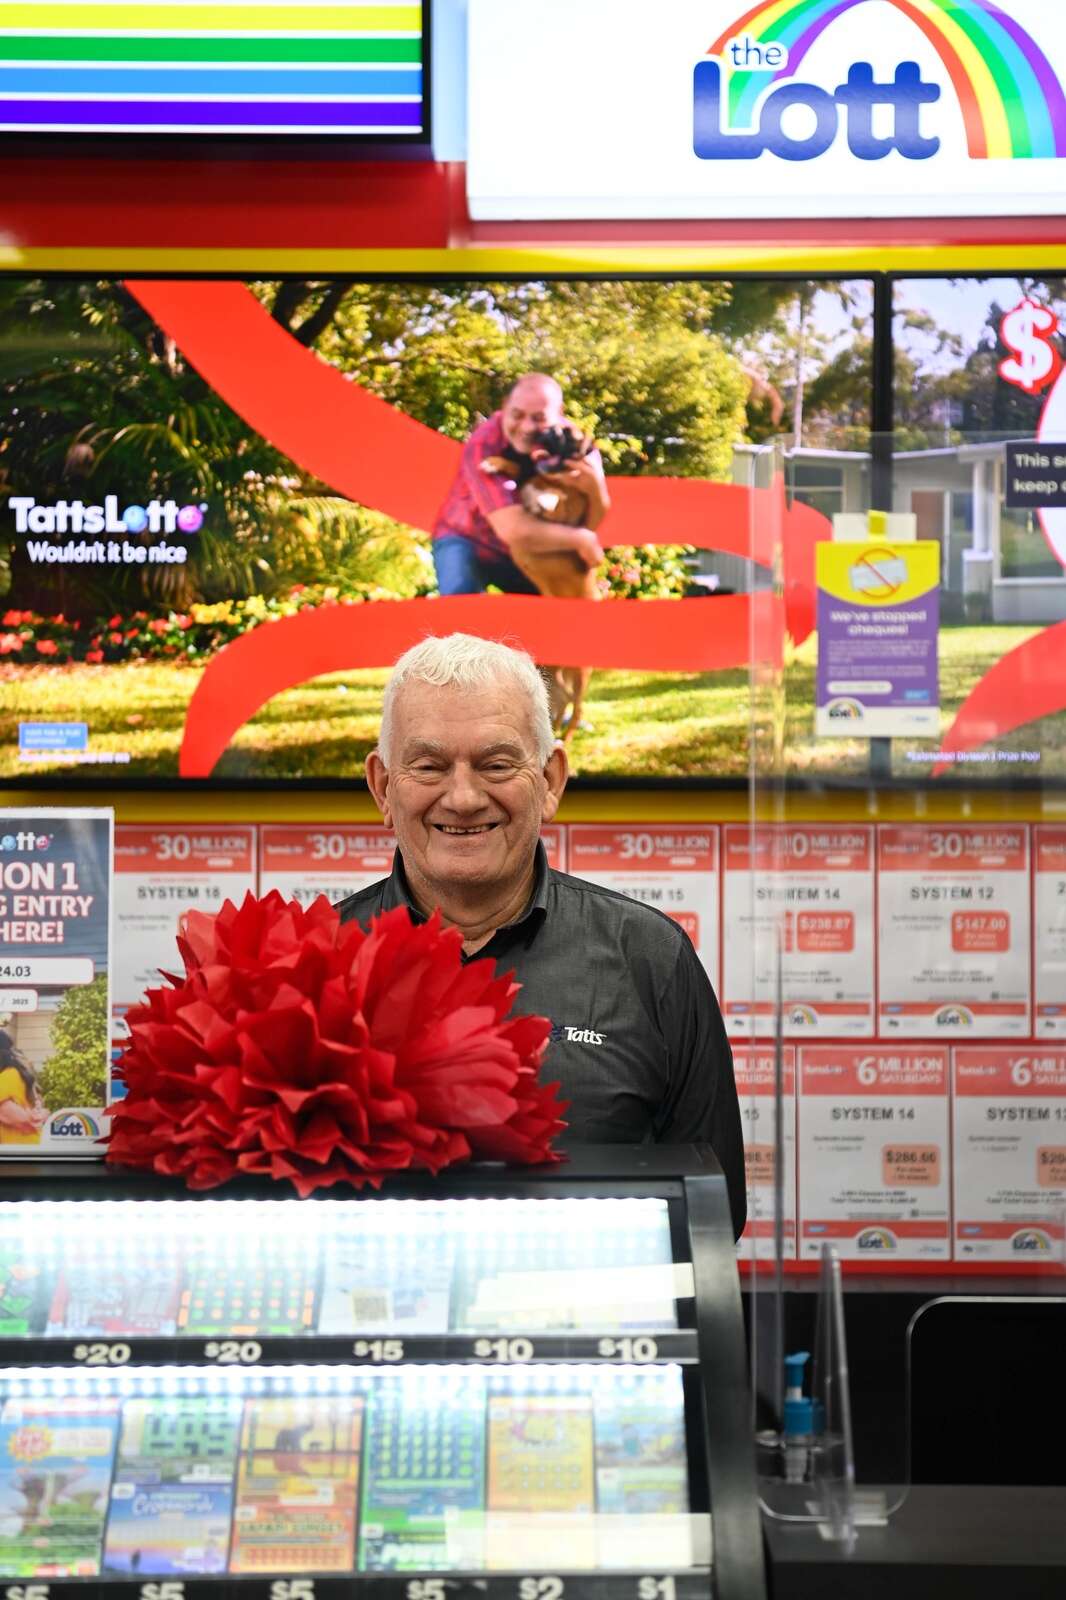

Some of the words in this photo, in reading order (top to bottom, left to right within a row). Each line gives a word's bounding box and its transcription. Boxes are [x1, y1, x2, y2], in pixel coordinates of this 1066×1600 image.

[731, 38, 782, 66] the
[693, 61, 941, 161] Lott
[1014, 452, 1050, 468] This
[1013, 478, 1058, 496] keep
[9, 494, 204, 534] TattsLotto
[27, 540, 105, 563] Wouldn't
[107, 540, 121, 563] it
[123, 540, 147, 563] be
[149, 540, 187, 563] nice
[0, 832, 50, 851] otto
[655, 836, 710, 849] MILLION
[62, 862, 79, 890] 1
[138, 886, 200, 899] SYSTEM
[824, 887, 841, 900] 14
[911, 887, 972, 900] SYSTEM
[978, 887, 994, 900] 12
[13, 895, 94, 917] ENTRY
[564, 1026, 607, 1045] Tatts
[878, 1056, 943, 1073] MILLION
[744, 1108, 759, 1120] 15
[831, 1107, 894, 1120] SYSTEM
[898, 1107, 915, 1120] 14
[986, 1107, 1050, 1121] SYSTEM
[50, 1121, 83, 1136] Lott
[73, 1343, 131, 1364] $20
[204, 1341, 262, 1363] $20
[353, 1340, 404, 1362] $15
[474, 1338, 534, 1362] $10
[598, 1338, 658, 1362] $10
[141, 1582, 185, 1600] $5
[270, 1580, 315, 1600] $5
[407, 1579, 446, 1600] $5
[519, 1576, 564, 1600] $2
[638, 1576, 677, 1600] $1
